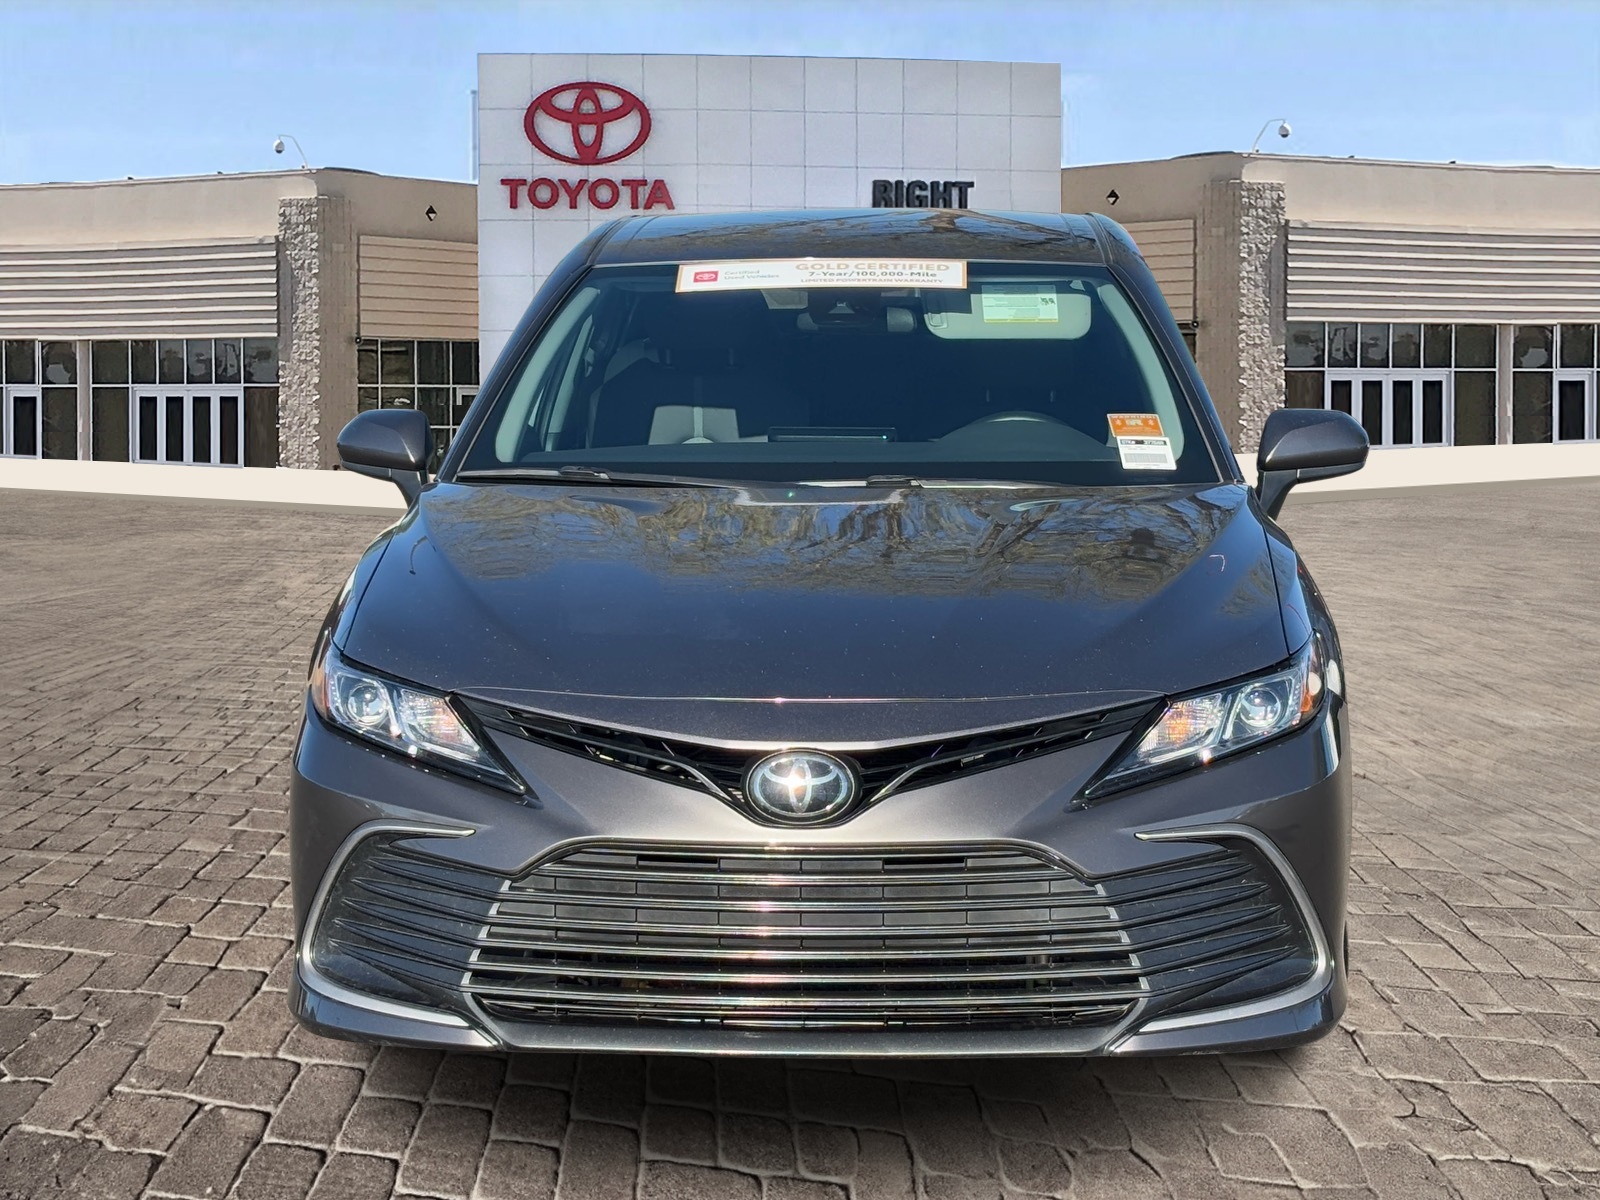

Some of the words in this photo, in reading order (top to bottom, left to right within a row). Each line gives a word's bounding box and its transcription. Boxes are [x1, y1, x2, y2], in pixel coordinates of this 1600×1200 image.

[500, 178, 675, 209] TOYOTA
[872, 180, 975, 209] RIGHT
[795, 262, 850, 271] GOLD
[854, 263, 950, 272] CERTIFIED
[808, 270, 938, 278] 7-Year/100,000-Mile
